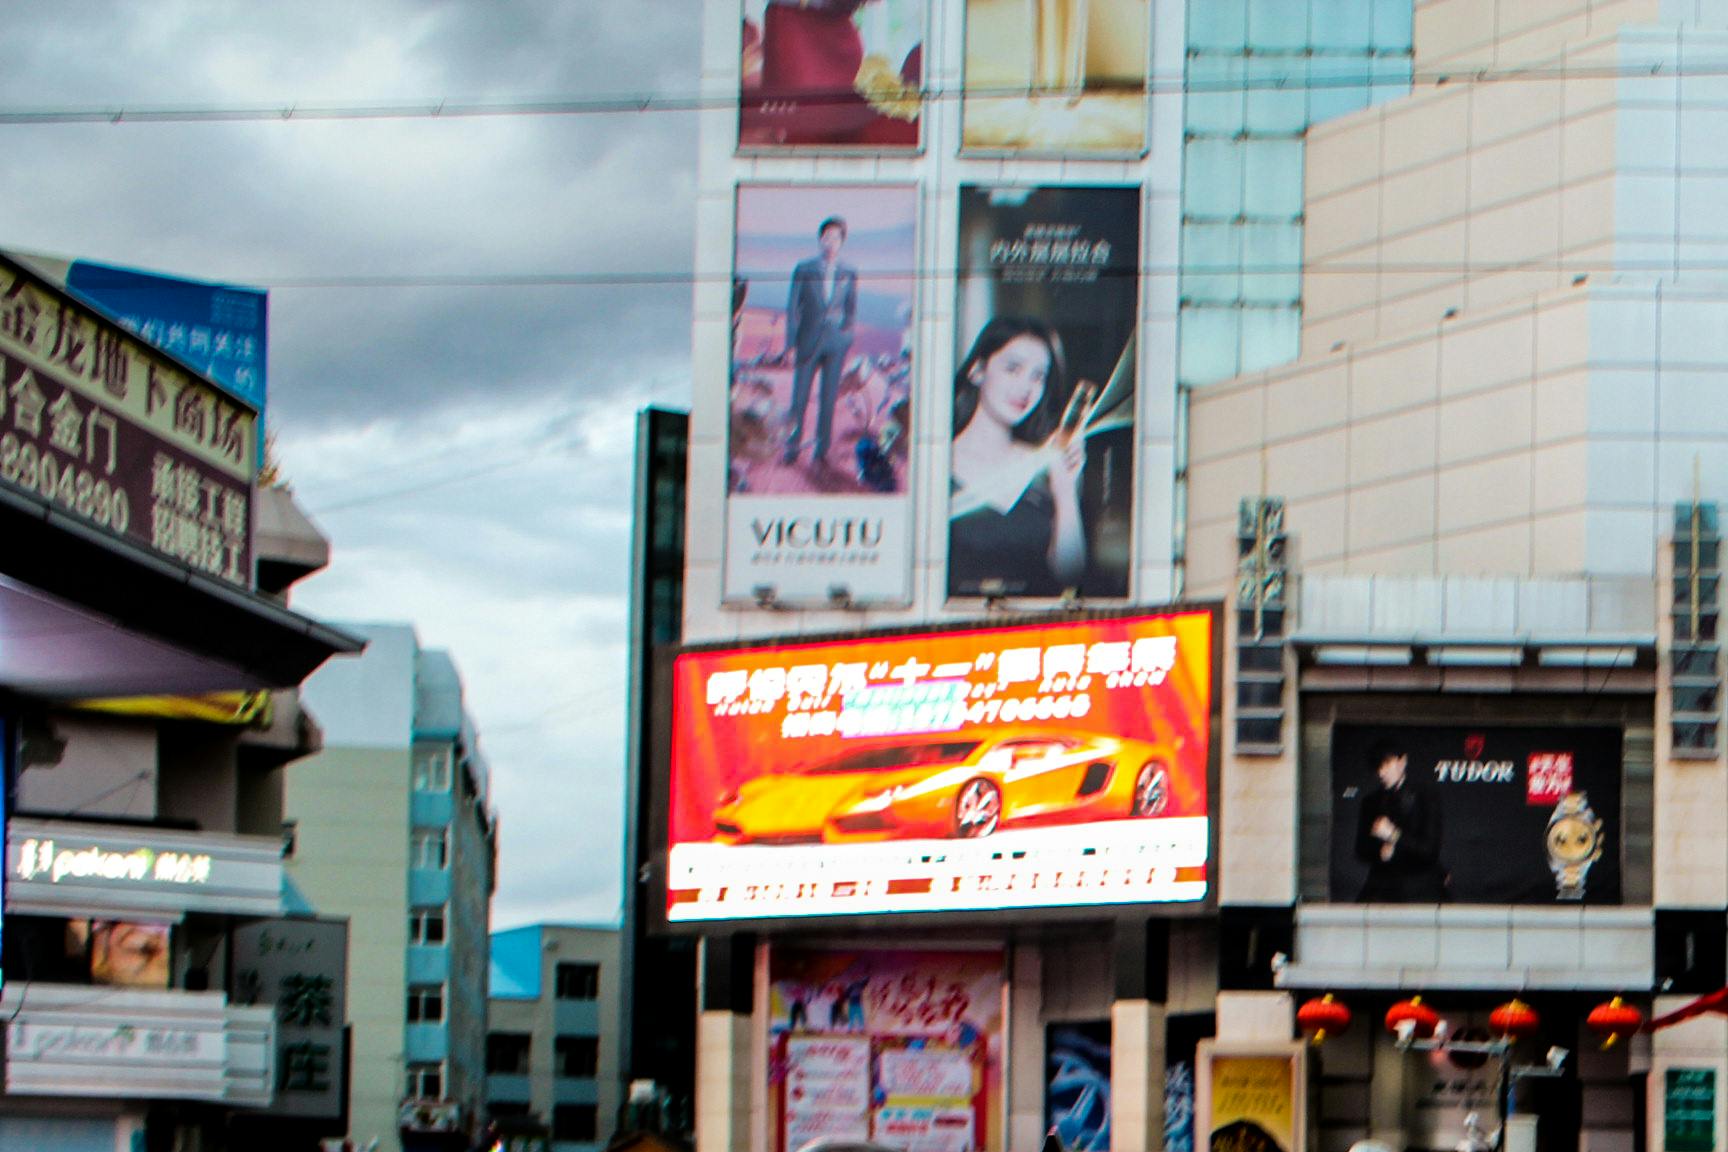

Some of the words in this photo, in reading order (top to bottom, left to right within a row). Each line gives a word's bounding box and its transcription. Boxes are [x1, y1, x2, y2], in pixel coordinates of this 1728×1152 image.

[751, 515, 884, 549] VICUTU
[1434, 760, 1516, 784] TUDOR
[278, 972, 334, 1091] 茶庄
